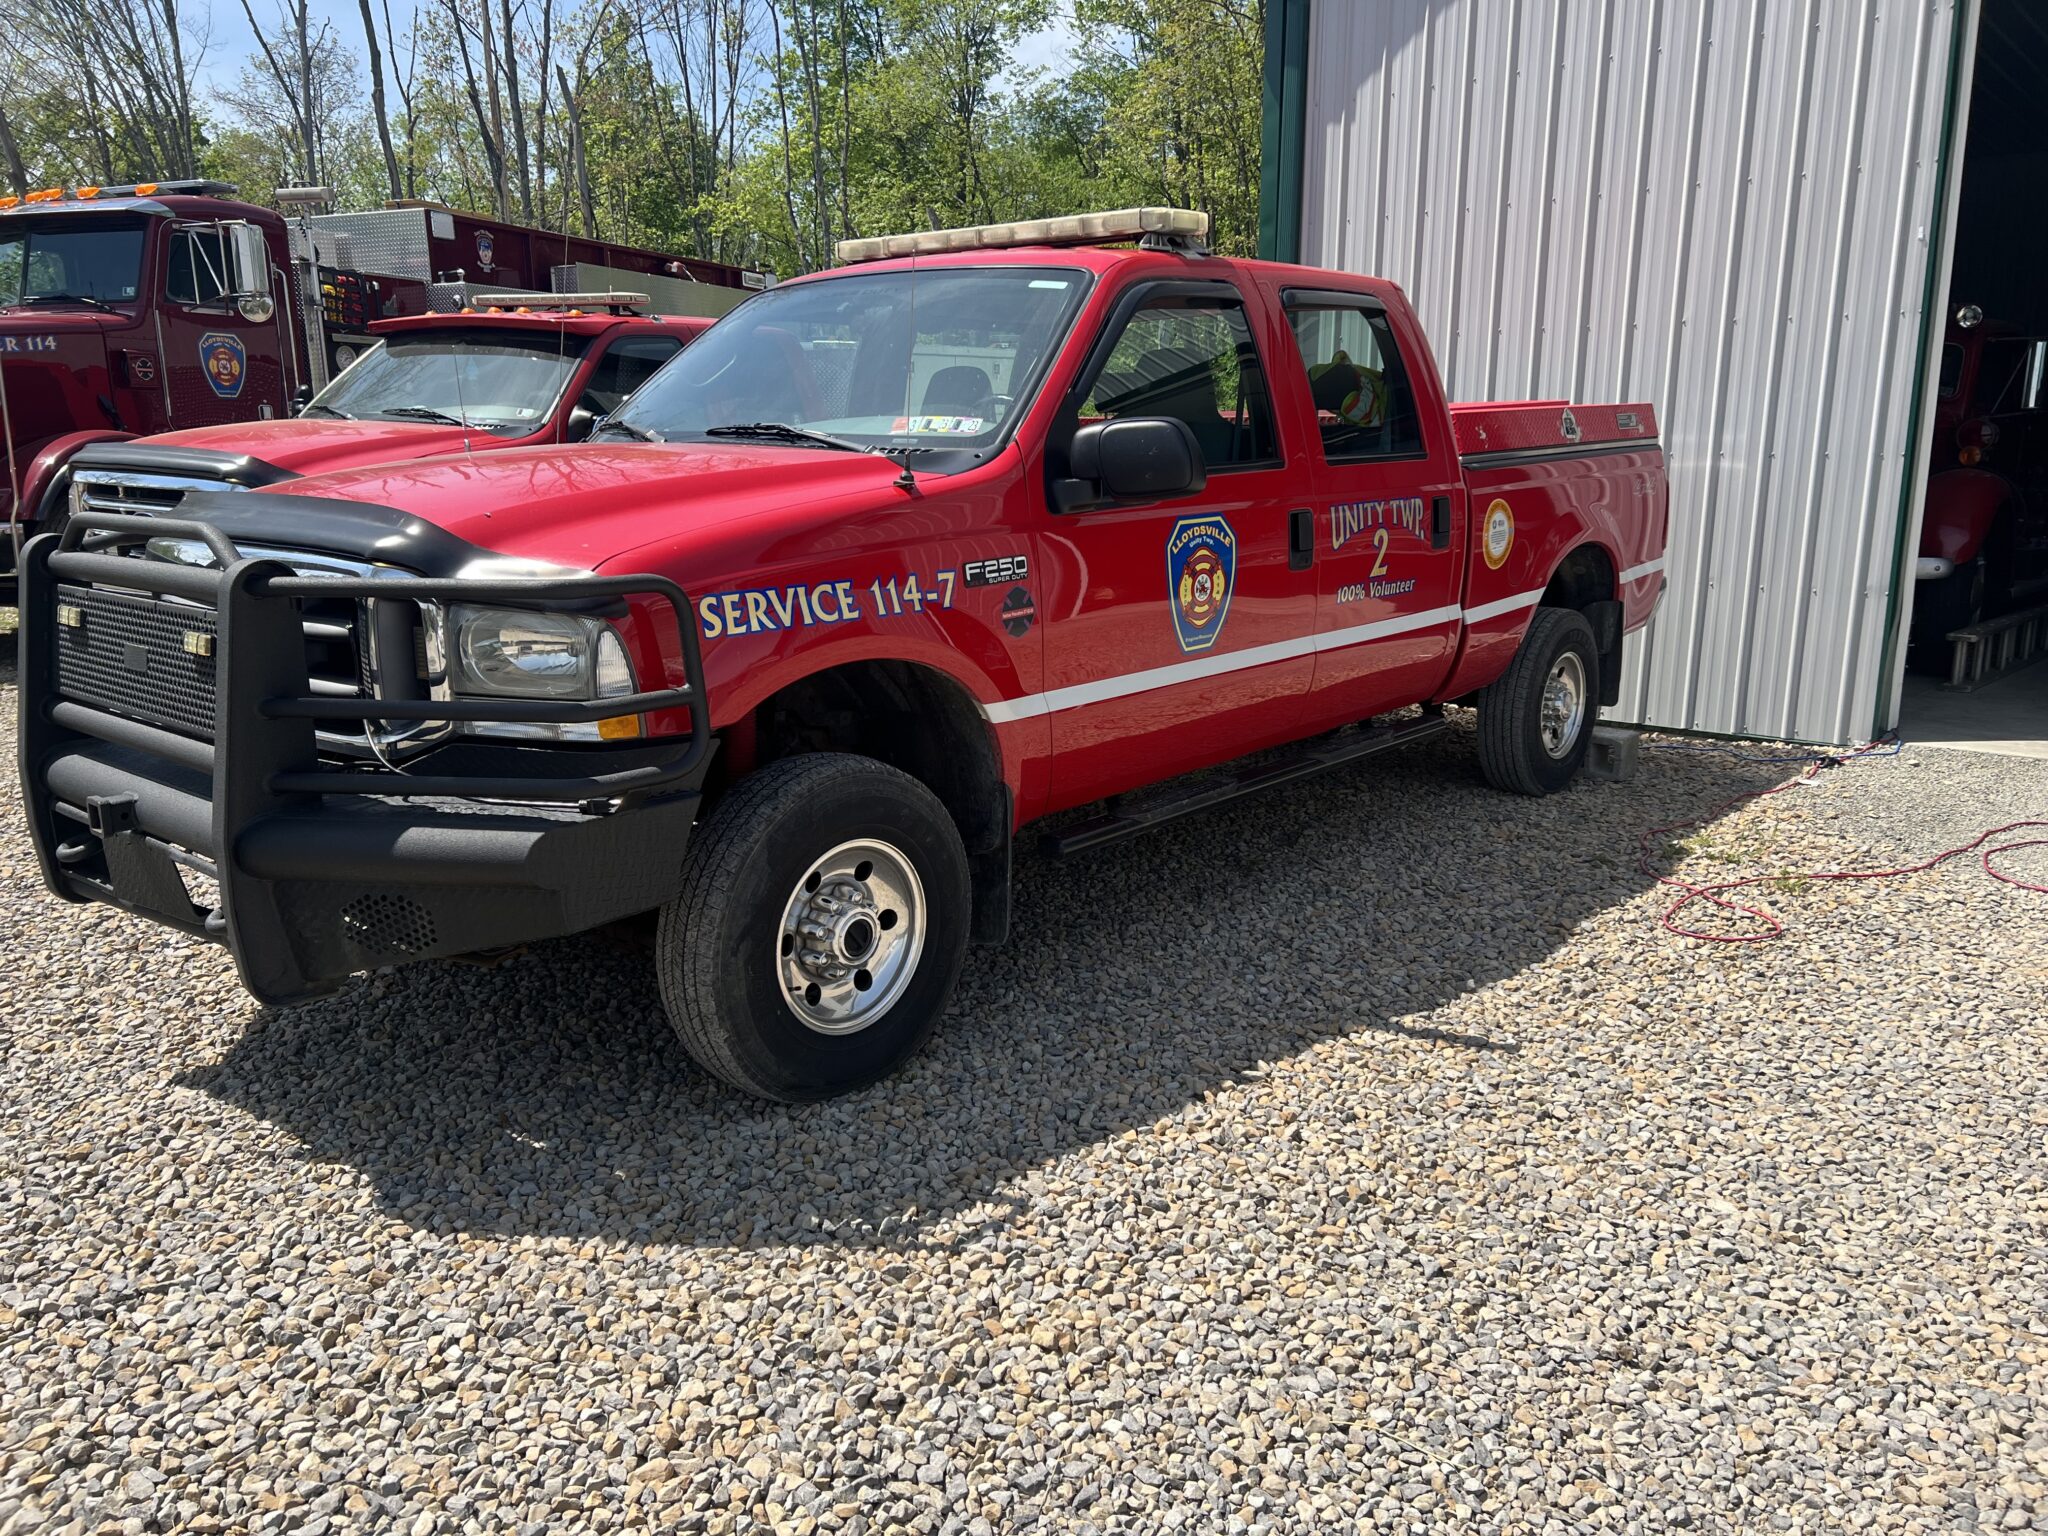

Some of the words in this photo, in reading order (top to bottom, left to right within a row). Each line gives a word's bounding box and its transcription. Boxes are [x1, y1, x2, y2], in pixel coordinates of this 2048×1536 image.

[0, 335, 20, 352] R
[26, 334, 57, 352] 114
[1171, 525, 1232, 555] LLOYDSVILLE
[1329, 500, 1385, 551] UNITY
[1369, 527, 1389, 578] 2
[988, 575, 1010, 584] SUPER
[1011, 572, 1028, 580] DUTY
[1336, 584, 1366, 604] 100%
[1369, 579, 1416, 598] Volunteer
[698, 580, 860, 639] SERVICE
[869, 571, 956, 617] 114-7
